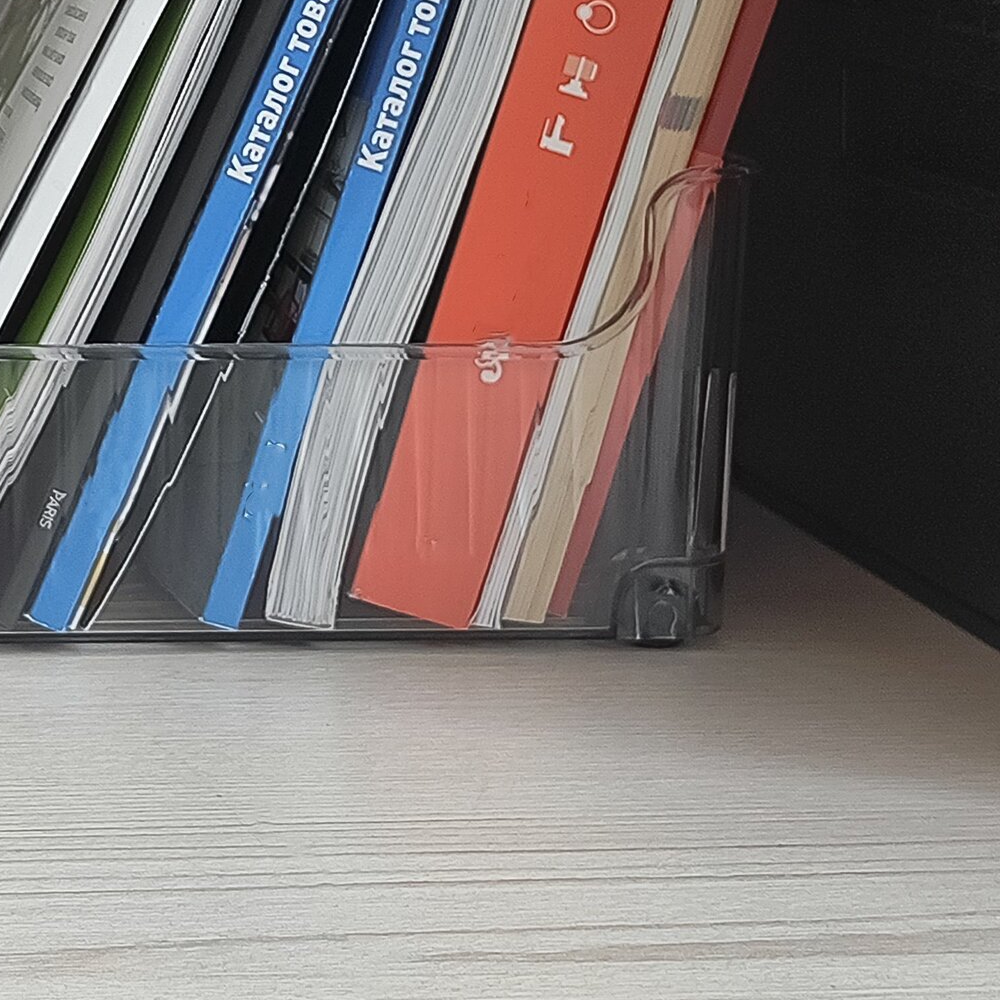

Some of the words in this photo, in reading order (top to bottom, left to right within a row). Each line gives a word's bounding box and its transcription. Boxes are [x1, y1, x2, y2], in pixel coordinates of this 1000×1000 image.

[226, 55, 301, 185] Каталог
[357, 41, 423, 173] Каталог
[39, 488, 68, 530] PARIS
